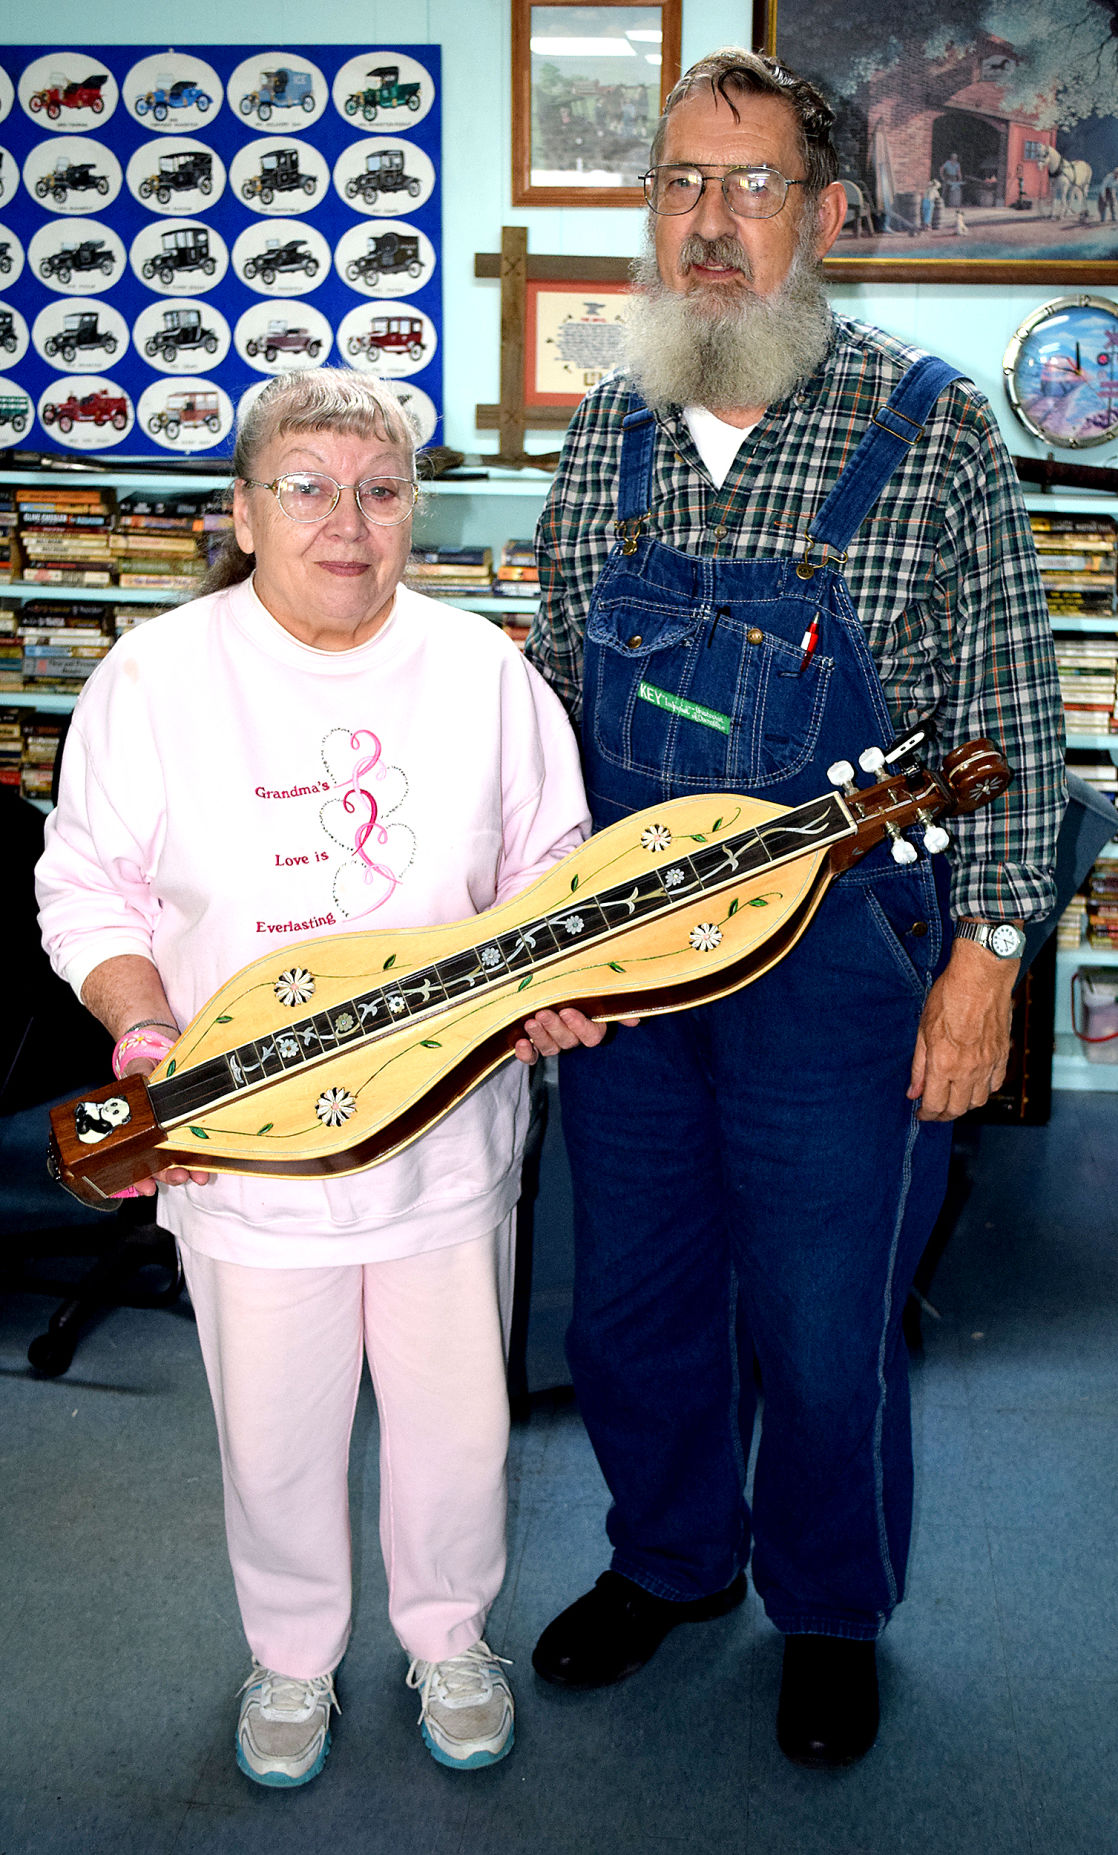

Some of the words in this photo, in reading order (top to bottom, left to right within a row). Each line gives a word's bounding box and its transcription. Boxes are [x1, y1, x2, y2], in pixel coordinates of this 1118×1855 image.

[640, 683, 663, 705] KEY
[255, 781, 330, 800] Grandma's
[275, 854, 309, 867] Love
[315, 851, 329, 863] is
[256, 912, 336, 934] Everlasting
